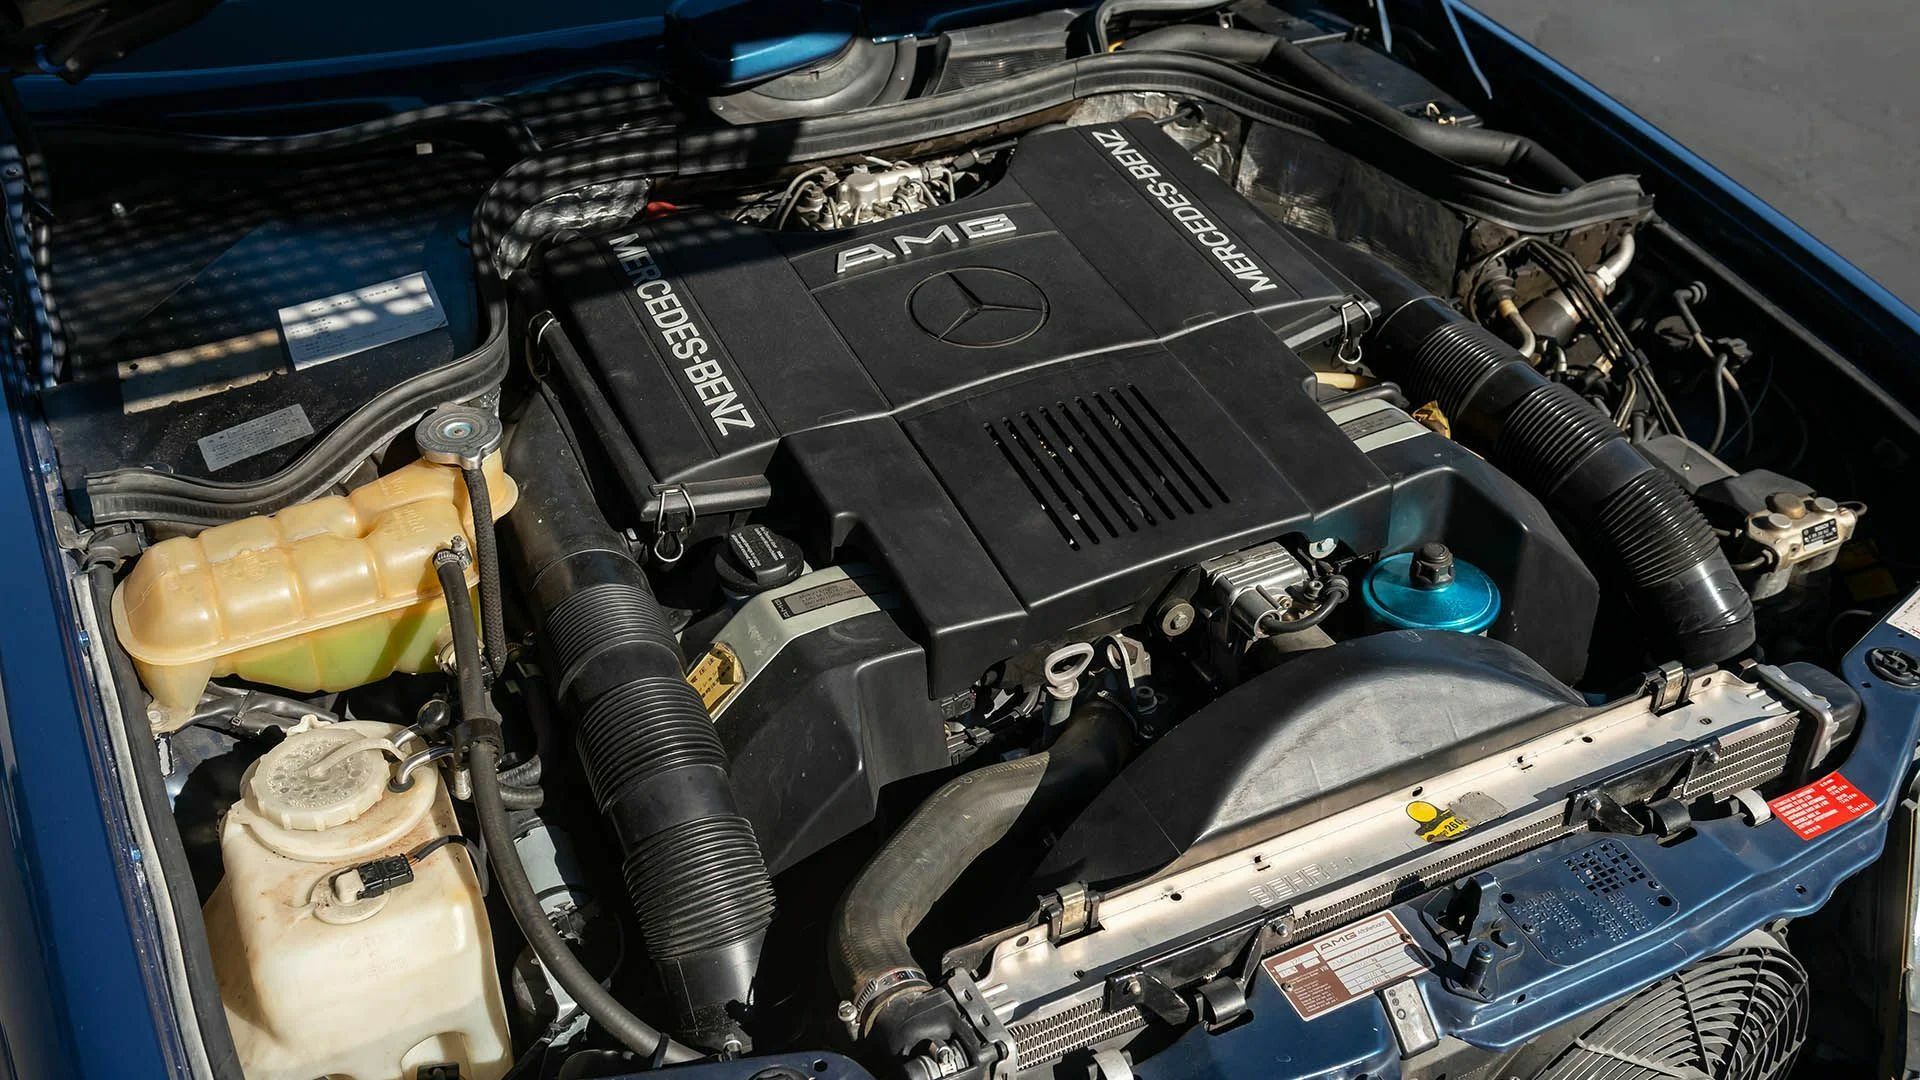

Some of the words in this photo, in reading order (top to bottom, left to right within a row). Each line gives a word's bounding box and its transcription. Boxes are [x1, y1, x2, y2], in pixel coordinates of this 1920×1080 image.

[1091, 128, 1278, 294] MERCEDES-BENZ
[836, 213, 1017, 274] AMG
[608, 232, 756, 437] MERCEDES-BENZ
[1247, 863, 1331, 907] BEHR
[1320, 931, 1358, 952] AMG
